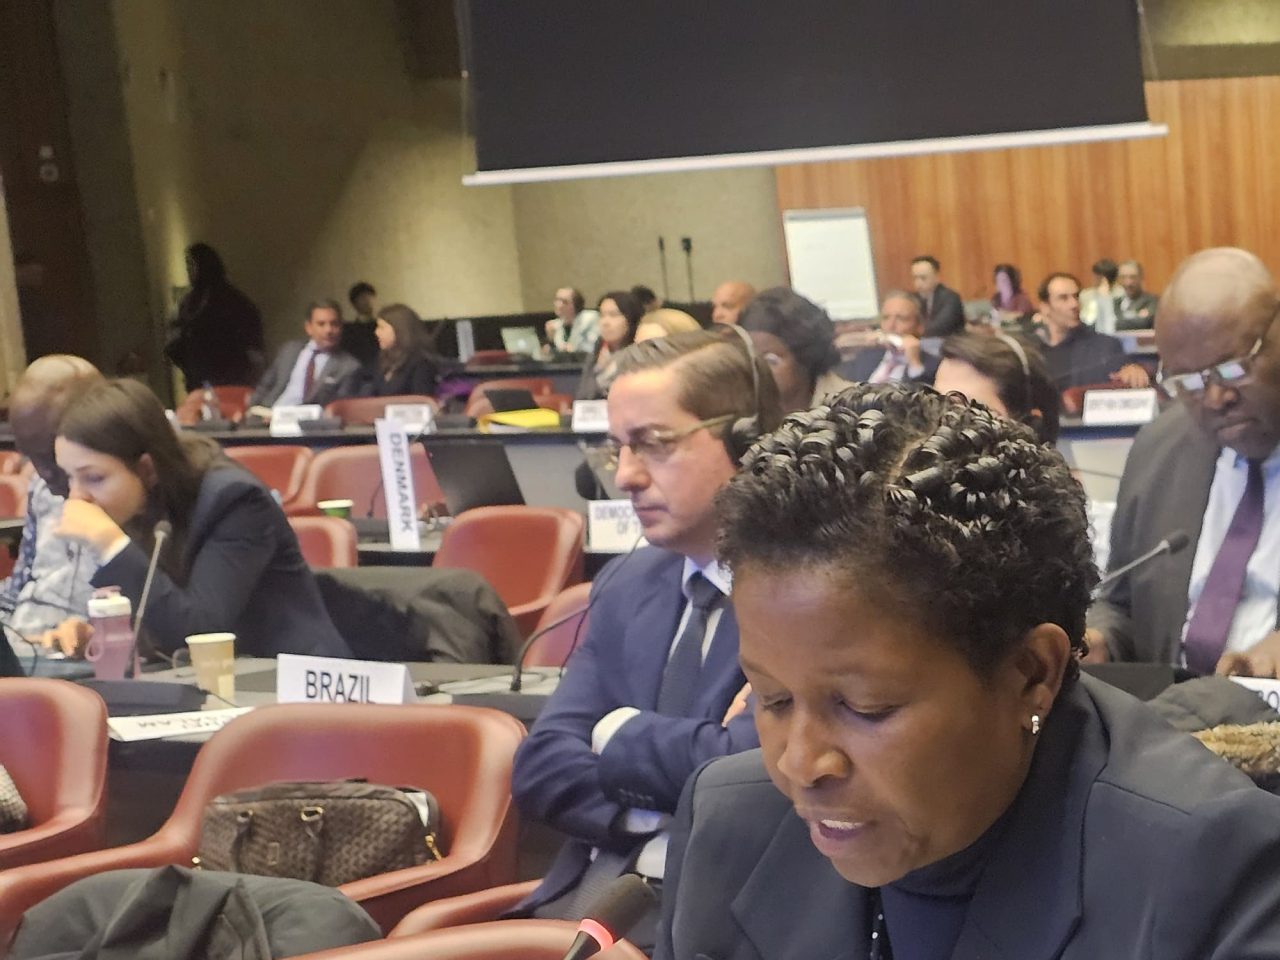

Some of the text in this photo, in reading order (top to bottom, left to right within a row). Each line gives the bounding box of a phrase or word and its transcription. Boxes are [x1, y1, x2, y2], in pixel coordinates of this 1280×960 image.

[390, 433, 413, 532] DENMARK
[595, 506, 637, 520] DEMOC
[305, 670, 376, 704] BRAZIL
